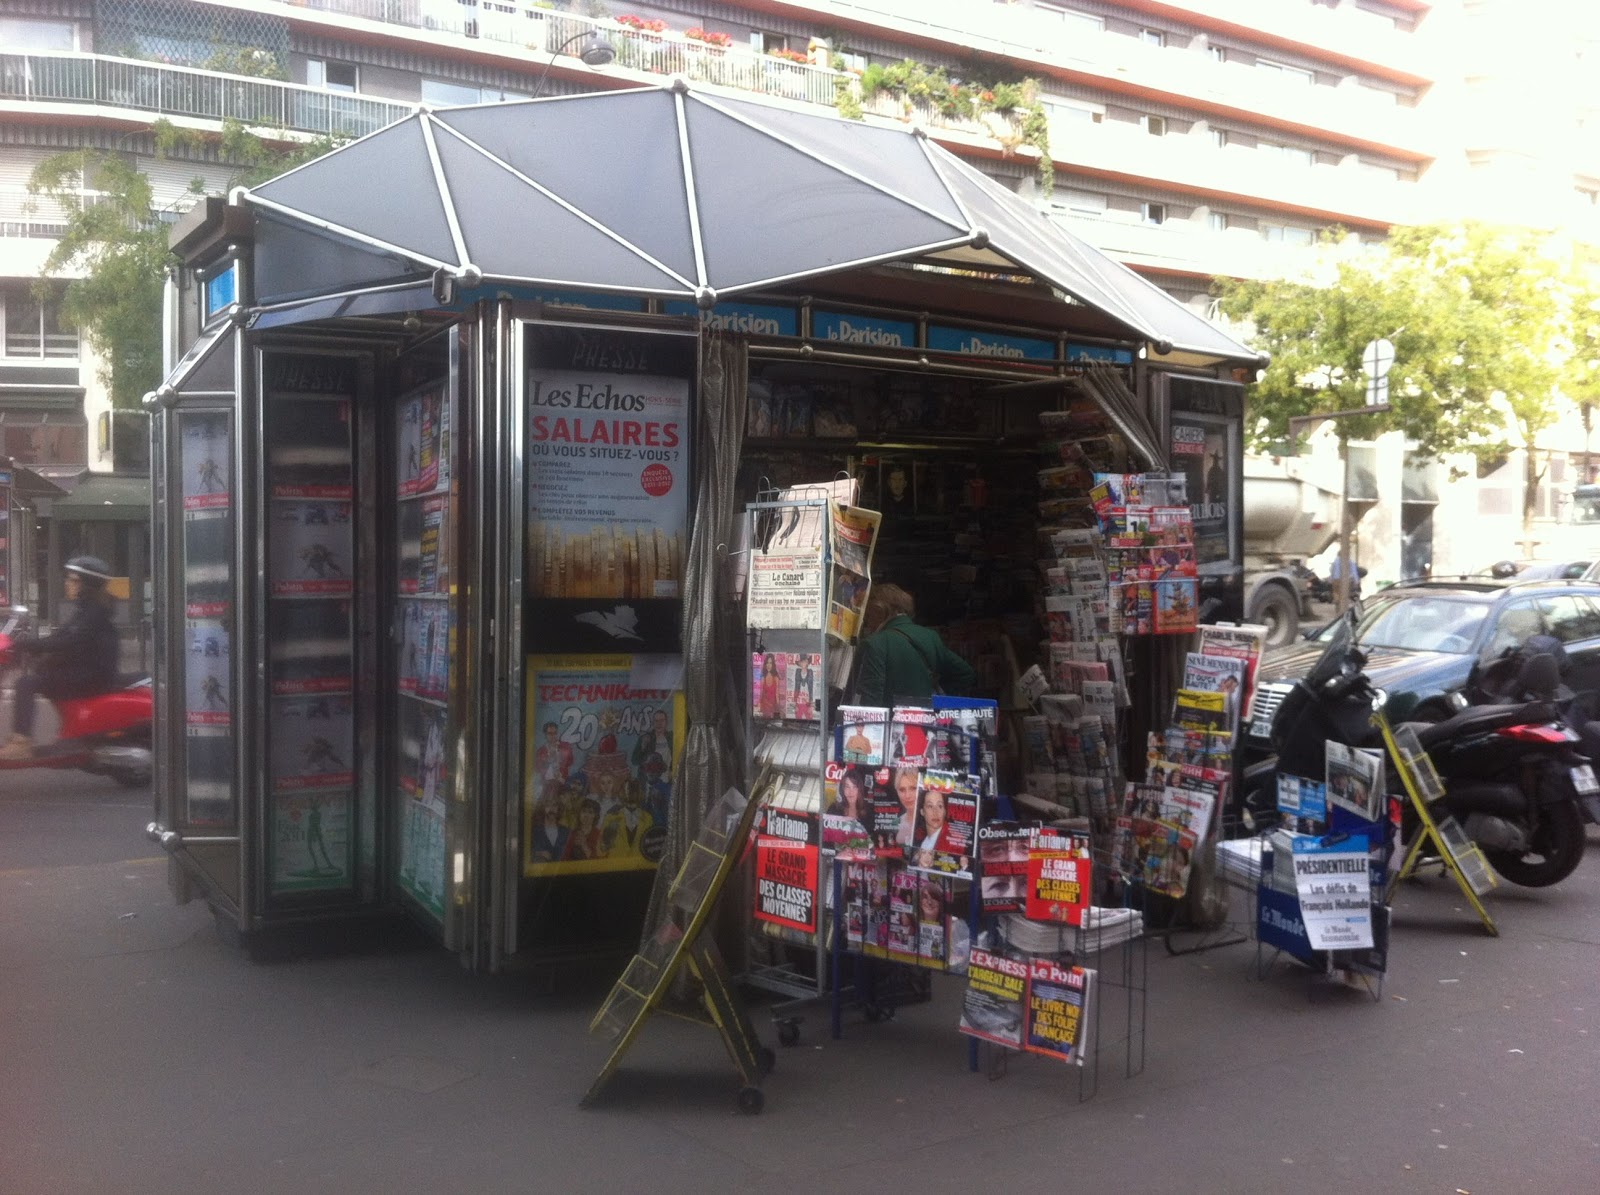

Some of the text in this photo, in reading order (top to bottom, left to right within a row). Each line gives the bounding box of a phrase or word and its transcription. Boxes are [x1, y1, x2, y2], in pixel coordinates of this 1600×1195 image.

[839, 320, 901, 347] Parisien
[531, 380, 645, 412] Les Echos
[532, 416, 679, 448] SALAIRES
[532, 442, 552, 456] OÙ
[552, 445, 586, 458] VOUS
[589, 447, 670, 462] SITUEZ-VOUS
[588, 509, 615, 517] REVENUS
[772, 573, 804, 582] Le Canard
[617, 706, 654, 735] ANS
[962, 707, 993, 720] BEAUTÉ
[560, 706, 599, 750] 20
[766, 809, 809, 841] Marianne
[767, 849, 806, 871] LE GRAND
[1043, 859, 1077, 871] LE GRAND
[1296, 857, 1367, 875] PRÉSIDENTIELLE
[765, 863, 807, 887] MASSACRE
[1040, 868, 1078, 881] MASSACRE
[759, 878, 812, 908] DES CLASSES
[1036, 879, 1080, 893] DES CLASSES
[1310, 882, 1357, 895] Les défis de
[1039, 890, 1078, 903] MOYENNES
[1301, 899, 1369, 914] François Hollande
[762, 897, 807, 924] MOYENNES
[970, 950, 1027, 978] L'EXPRESS
[1031, 965, 1048, 979] Le
